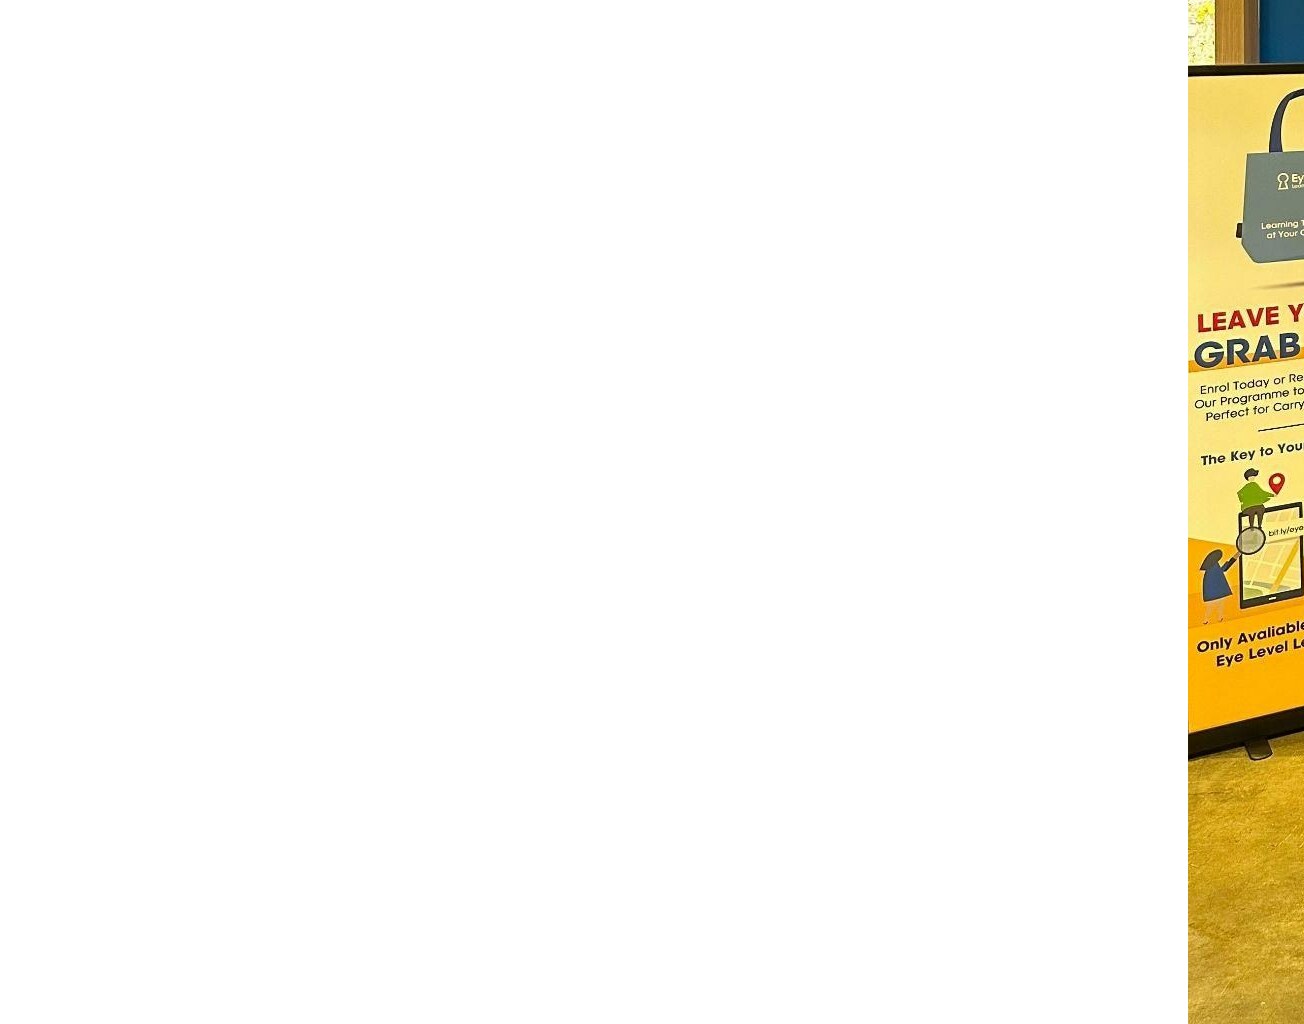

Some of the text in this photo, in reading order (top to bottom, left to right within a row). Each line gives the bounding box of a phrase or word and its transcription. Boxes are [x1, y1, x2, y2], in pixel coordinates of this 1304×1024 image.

[1261, 220, 1299, 230] Learning
[1266, 231, 1276, 239] at
[1278, 230, 1298, 238] Your
[1197, 305, 1280, 333] LEAVE
[1194, 331, 1301, 369] GRAB
[1200, 383, 1230, 395] Enrol
[1233, 378, 1270, 392] Today
[1273, 375, 1286, 385] or
[1194, 398, 1217, 409] Our
[1220, 389, 1289, 407] Programme
[1293, 386, 1304, 396] to
[1205, 407, 1250, 422] Perfect
[1253, 403, 1269, 416] for
[1201, 453, 1226, 466] The
[1230, 448, 1256, 463] Key
[1259, 445, 1273, 457] to
[1197, 637, 1233, 653] Only
[1216, 651, 1244, 667] Eye
[1248, 639, 1289, 660] Level
